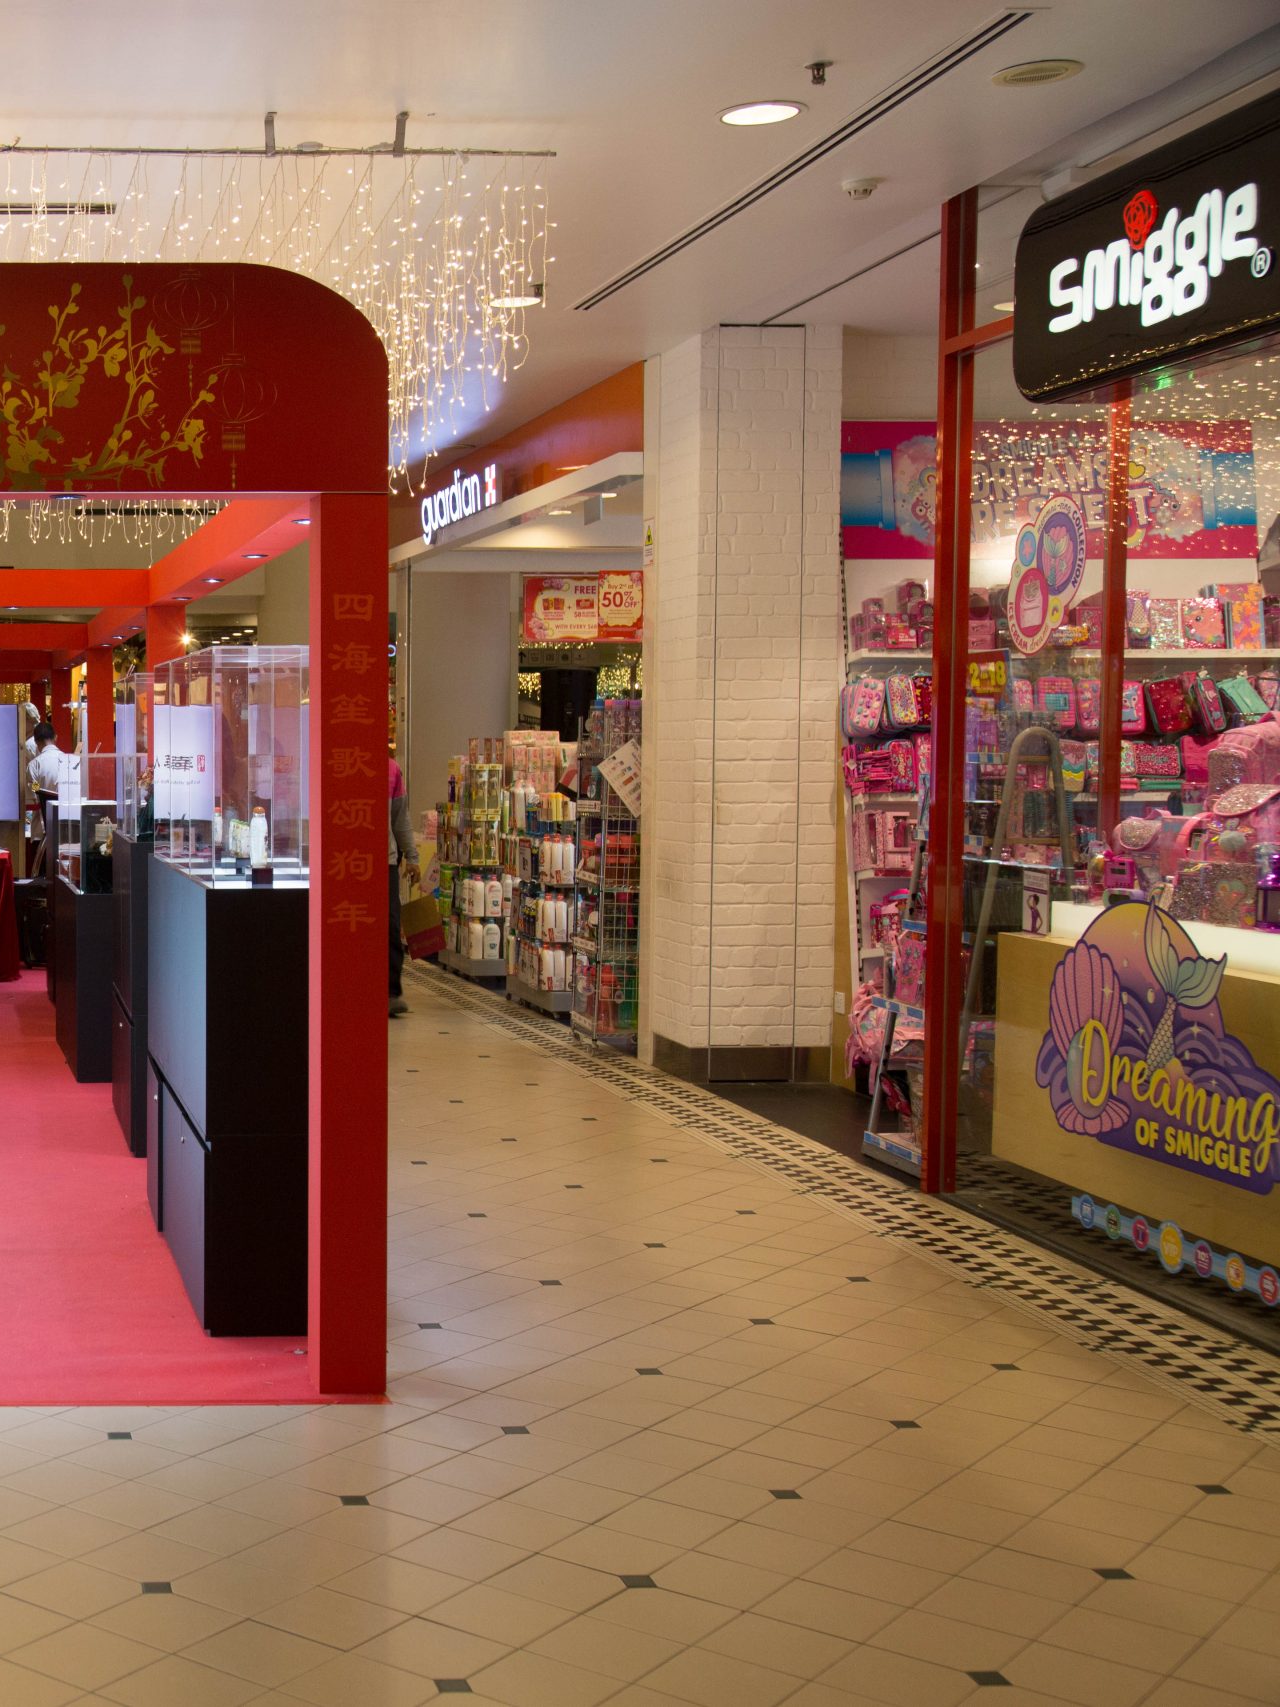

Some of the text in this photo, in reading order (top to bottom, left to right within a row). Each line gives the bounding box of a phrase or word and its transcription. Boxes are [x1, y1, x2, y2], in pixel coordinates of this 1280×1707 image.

[1048, 183, 1258, 333] smiggle
[421, 468, 481, 545] guardian
[1071, 510, 1085, 588] COLLECTION
[574, 585, 597, 595] FREE
[327, 593, 376, 932] 四海笙歌颂狗年
[1081, 1018, 1280, 1174] Dreaming
[1135, 1118, 1252, 1178] OF SMIGGLE
